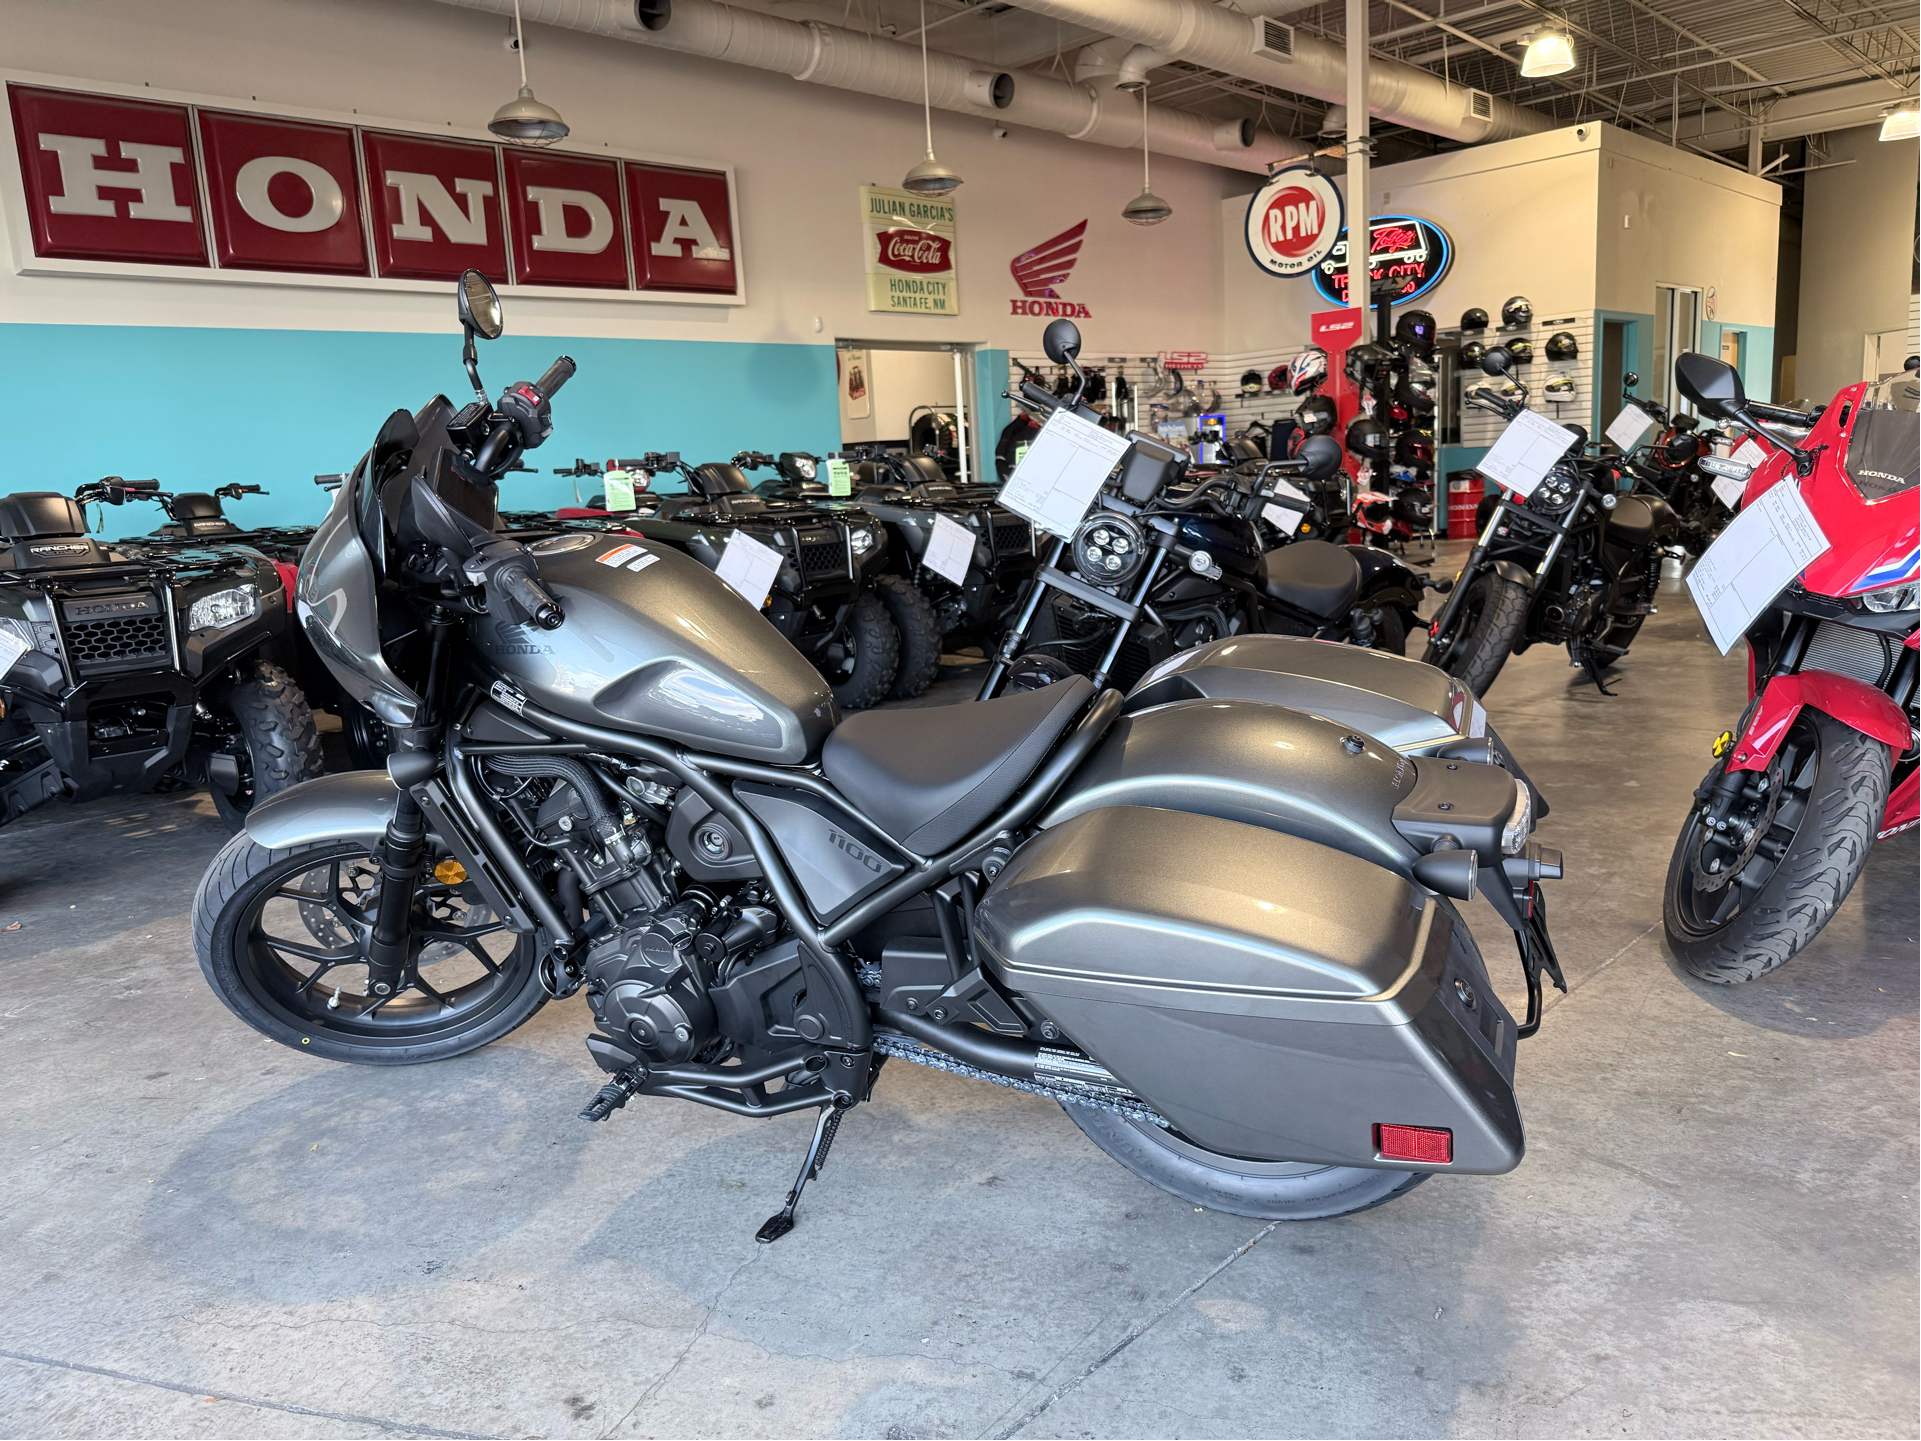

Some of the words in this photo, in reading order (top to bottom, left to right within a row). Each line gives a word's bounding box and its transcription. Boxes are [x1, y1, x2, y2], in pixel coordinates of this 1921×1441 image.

[37, 132, 731, 262] HONDA
[870, 198, 906, 217] JULIAN
[909, 202, 954, 222] GARCIA'S
[1268, 200, 1319, 244] RPM
[1269, 258, 1303, 269] MOTOR
[1307, 249, 1323, 263] OIL
[889, 278, 925, 295] HONDA
[926, 281, 947, 296] CITY
[891, 295, 918, 309] SANTA
[933, 298, 946, 310] NM
[1010, 299, 1092, 319] HONDA
[1319, 321, 1355, 333] LS2
[1157, 351, 1208, 363] LS2
[1857, 469, 1906, 485] HONDA
[30, 545, 90, 554] RANCHER
[75, 601, 149, 616] HONDA
[494, 644, 556, 655] HONDA
[828, 828, 883, 874] 1100
